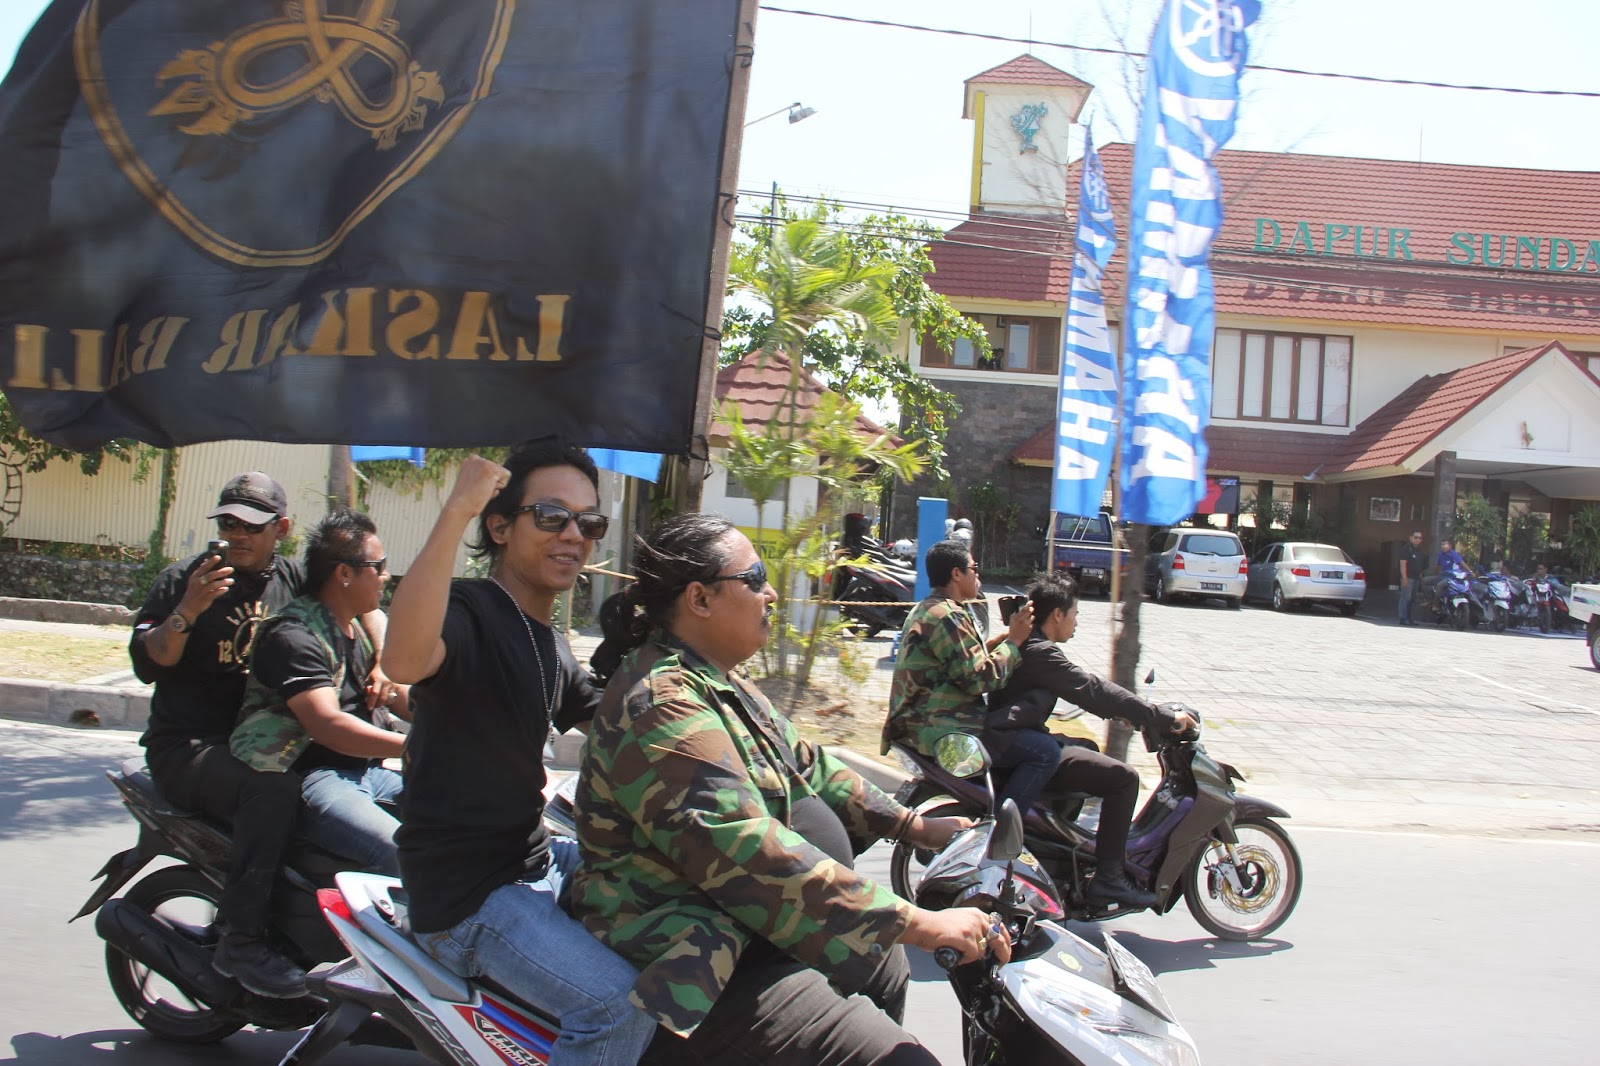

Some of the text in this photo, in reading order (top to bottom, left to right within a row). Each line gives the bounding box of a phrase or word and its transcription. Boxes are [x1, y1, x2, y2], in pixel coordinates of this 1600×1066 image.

[1251, 218, 1600, 274] DAPUR SUNDA
[1131, 87, 1236, 484] YAMAHA
[473, 1012, 543, 1066] VARI
